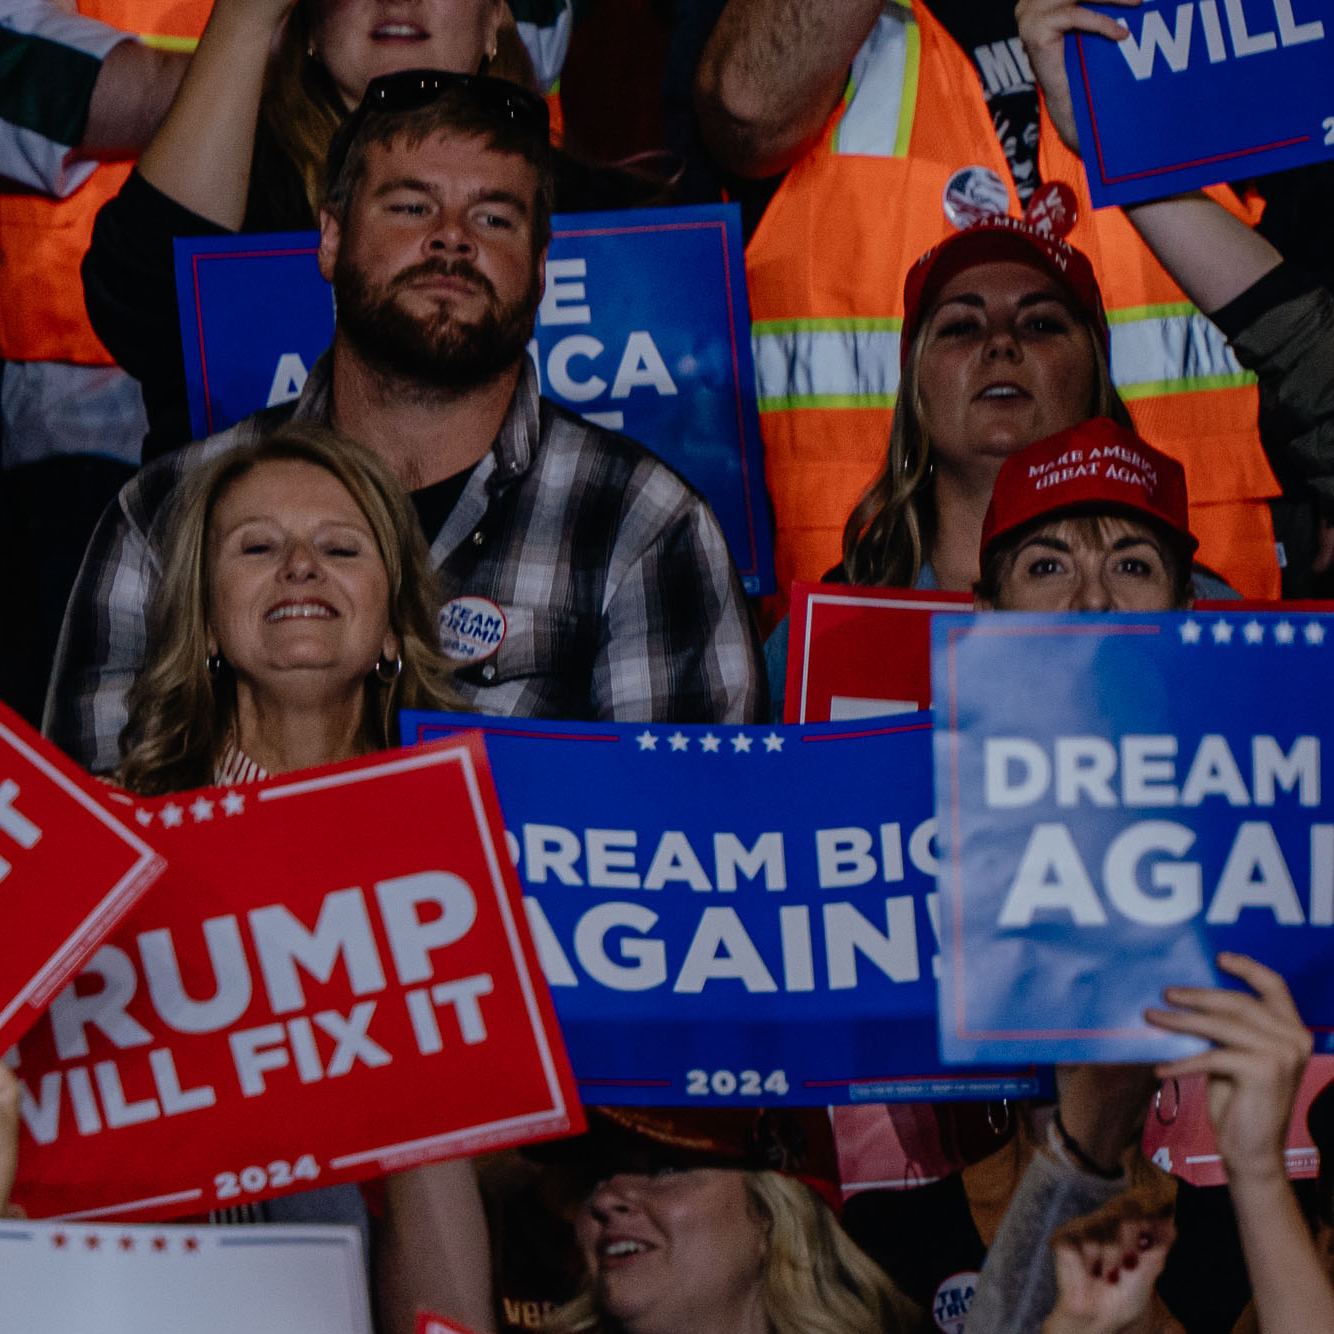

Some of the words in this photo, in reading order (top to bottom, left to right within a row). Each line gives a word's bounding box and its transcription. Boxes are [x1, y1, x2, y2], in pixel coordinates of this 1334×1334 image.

[1113, 0, 1323, 80] WILL
[1028, 448, 1083, 480] MAKE
[1035, 461, 1100, 492] GREAT
[983, 733, 1322, 809] DREAM
[509, 822, 788, 893] REAM
[815, 817, 940, 890] BIG
[12, 870, 477, 1066] RUMP
[15, 1048, 216, 1145] WILL
[228, 1001, 392, 1097] FIX
[404, 974, 495, 1056] IT
[686, 1068, 790, 1096] 2024
[214, 1154, 322, 1198] 2024
